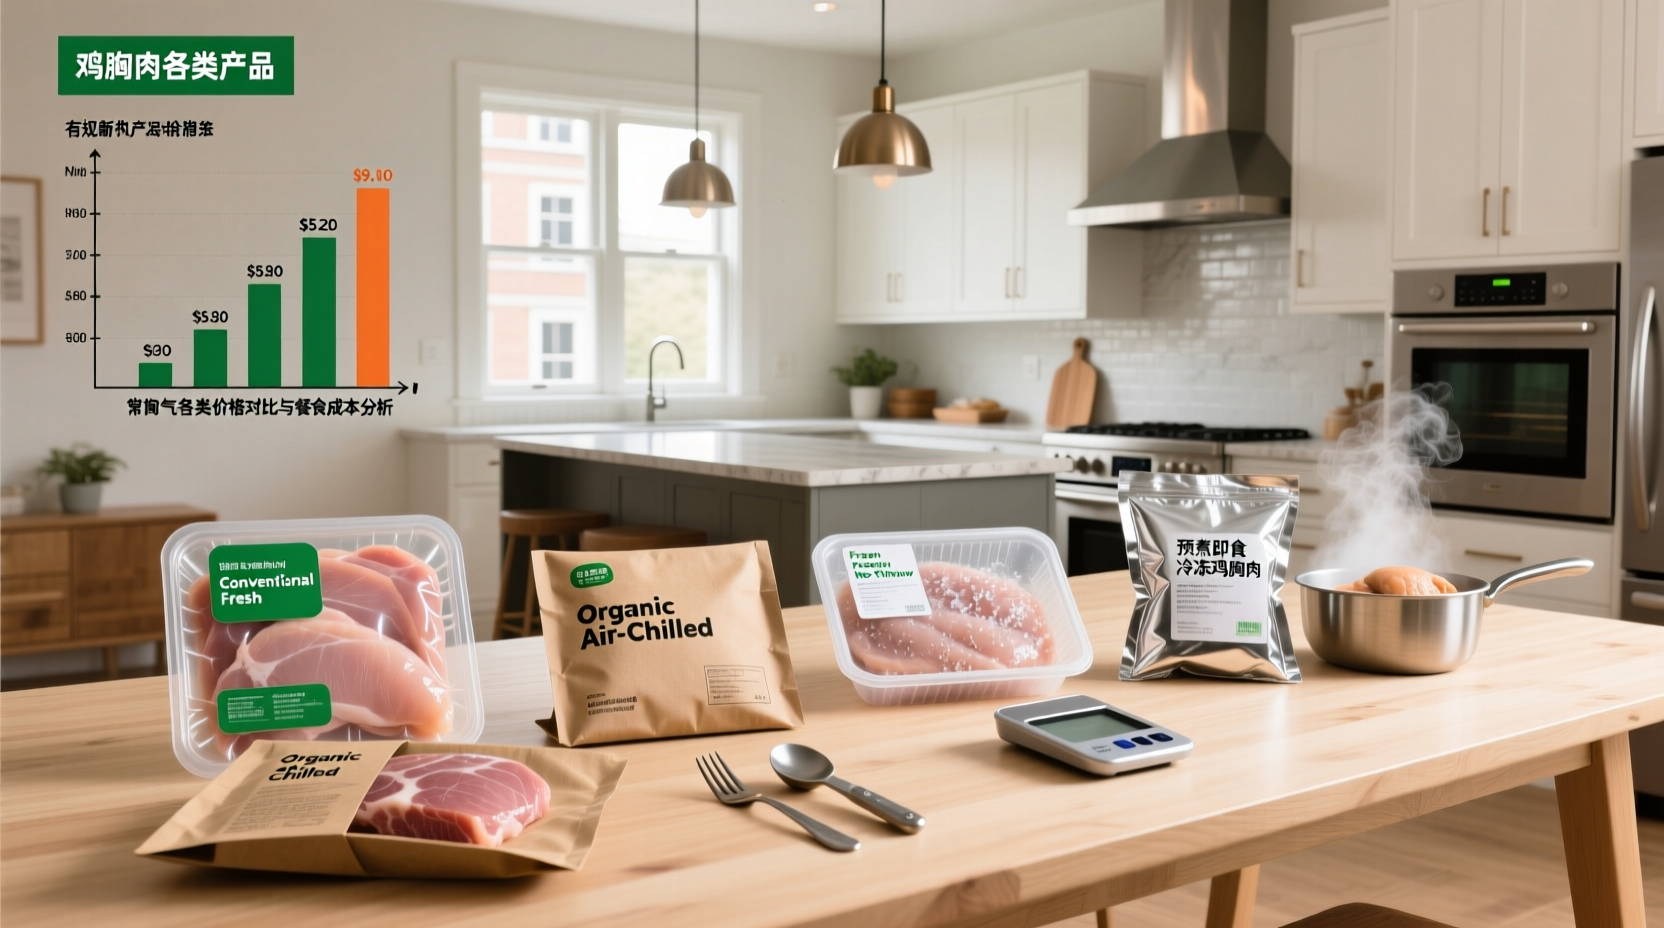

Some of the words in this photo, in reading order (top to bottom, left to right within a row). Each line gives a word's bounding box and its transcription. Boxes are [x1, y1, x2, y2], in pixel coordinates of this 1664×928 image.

[221, 591, 262, 606] Fresh
[577, 596, 675, 625] Organic
[580, 616, 713, 650] Air-Chilled
[280, 751, 362, 766] Organic
